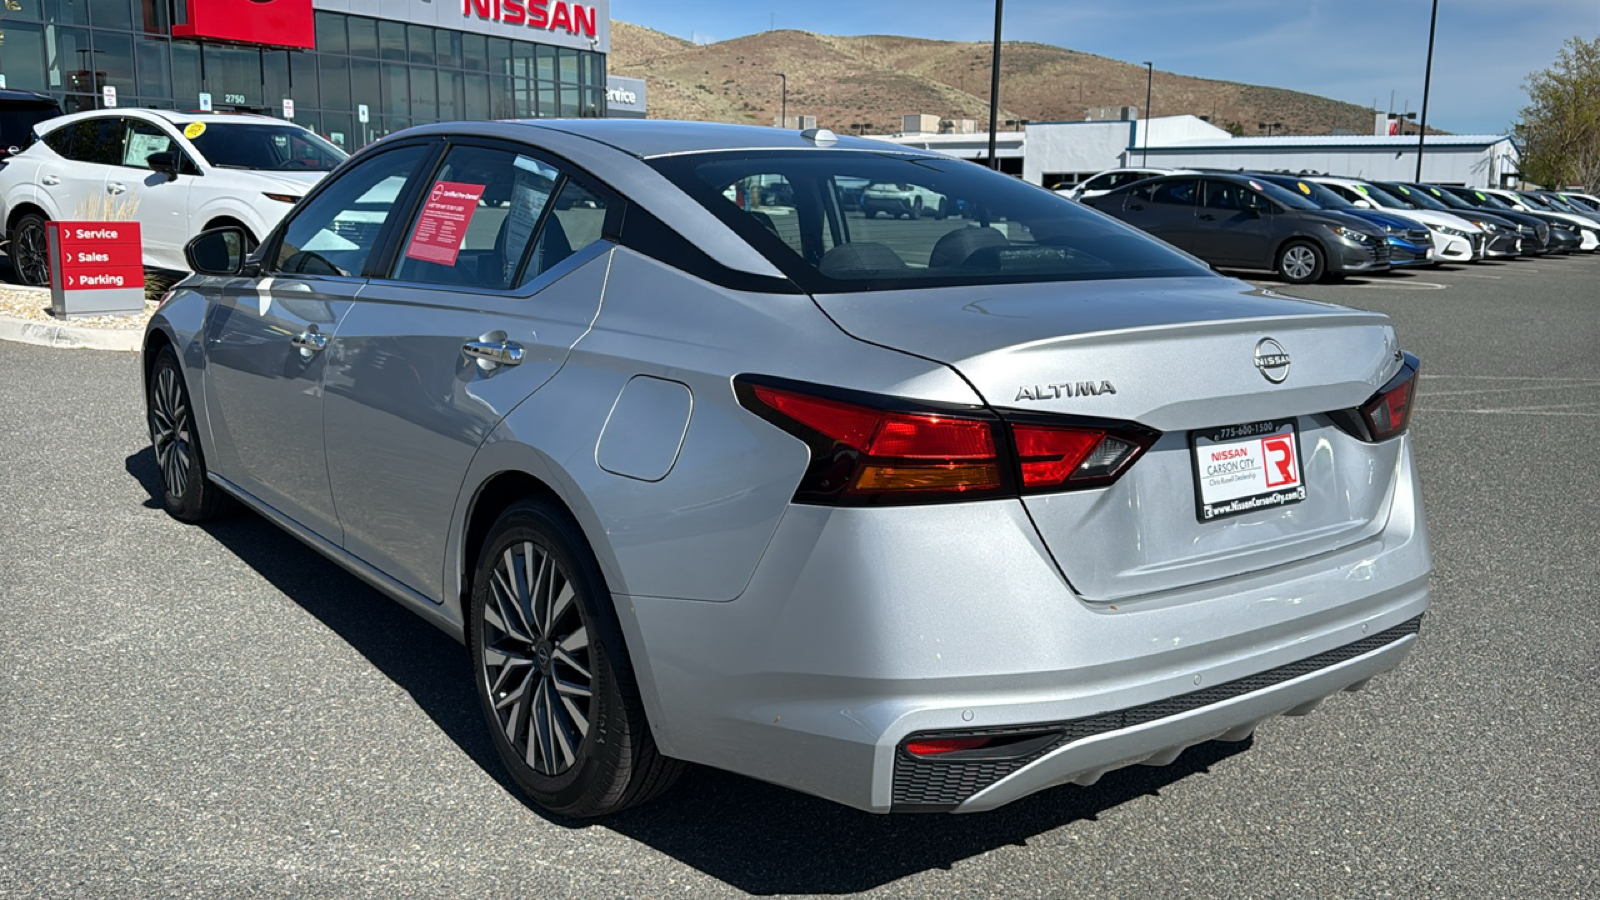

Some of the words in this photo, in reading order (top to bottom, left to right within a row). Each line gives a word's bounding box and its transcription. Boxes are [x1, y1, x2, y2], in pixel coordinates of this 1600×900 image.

[463, 0, 596, 37] NISSAN
[225, 94, 245, 104] 2750
[76, 229, 118, 239] Service
[78, 252, 109, 262] Sales
[79, 274, 124, 286] Parking
[1254, 354, 1291, 367] NISSAN
[1014, 380, 1116, 401] ALTIMA
[1221, 422, 1273, 438] 775-600-1500
[1211, 447, 1247, 461] NISSAN
[1207, 459, 1239, 475] CARSON
[1239, 458, 1255, 470] CITY
[1213, 491, 1297, 515] www.NissanCarsonCity.com
